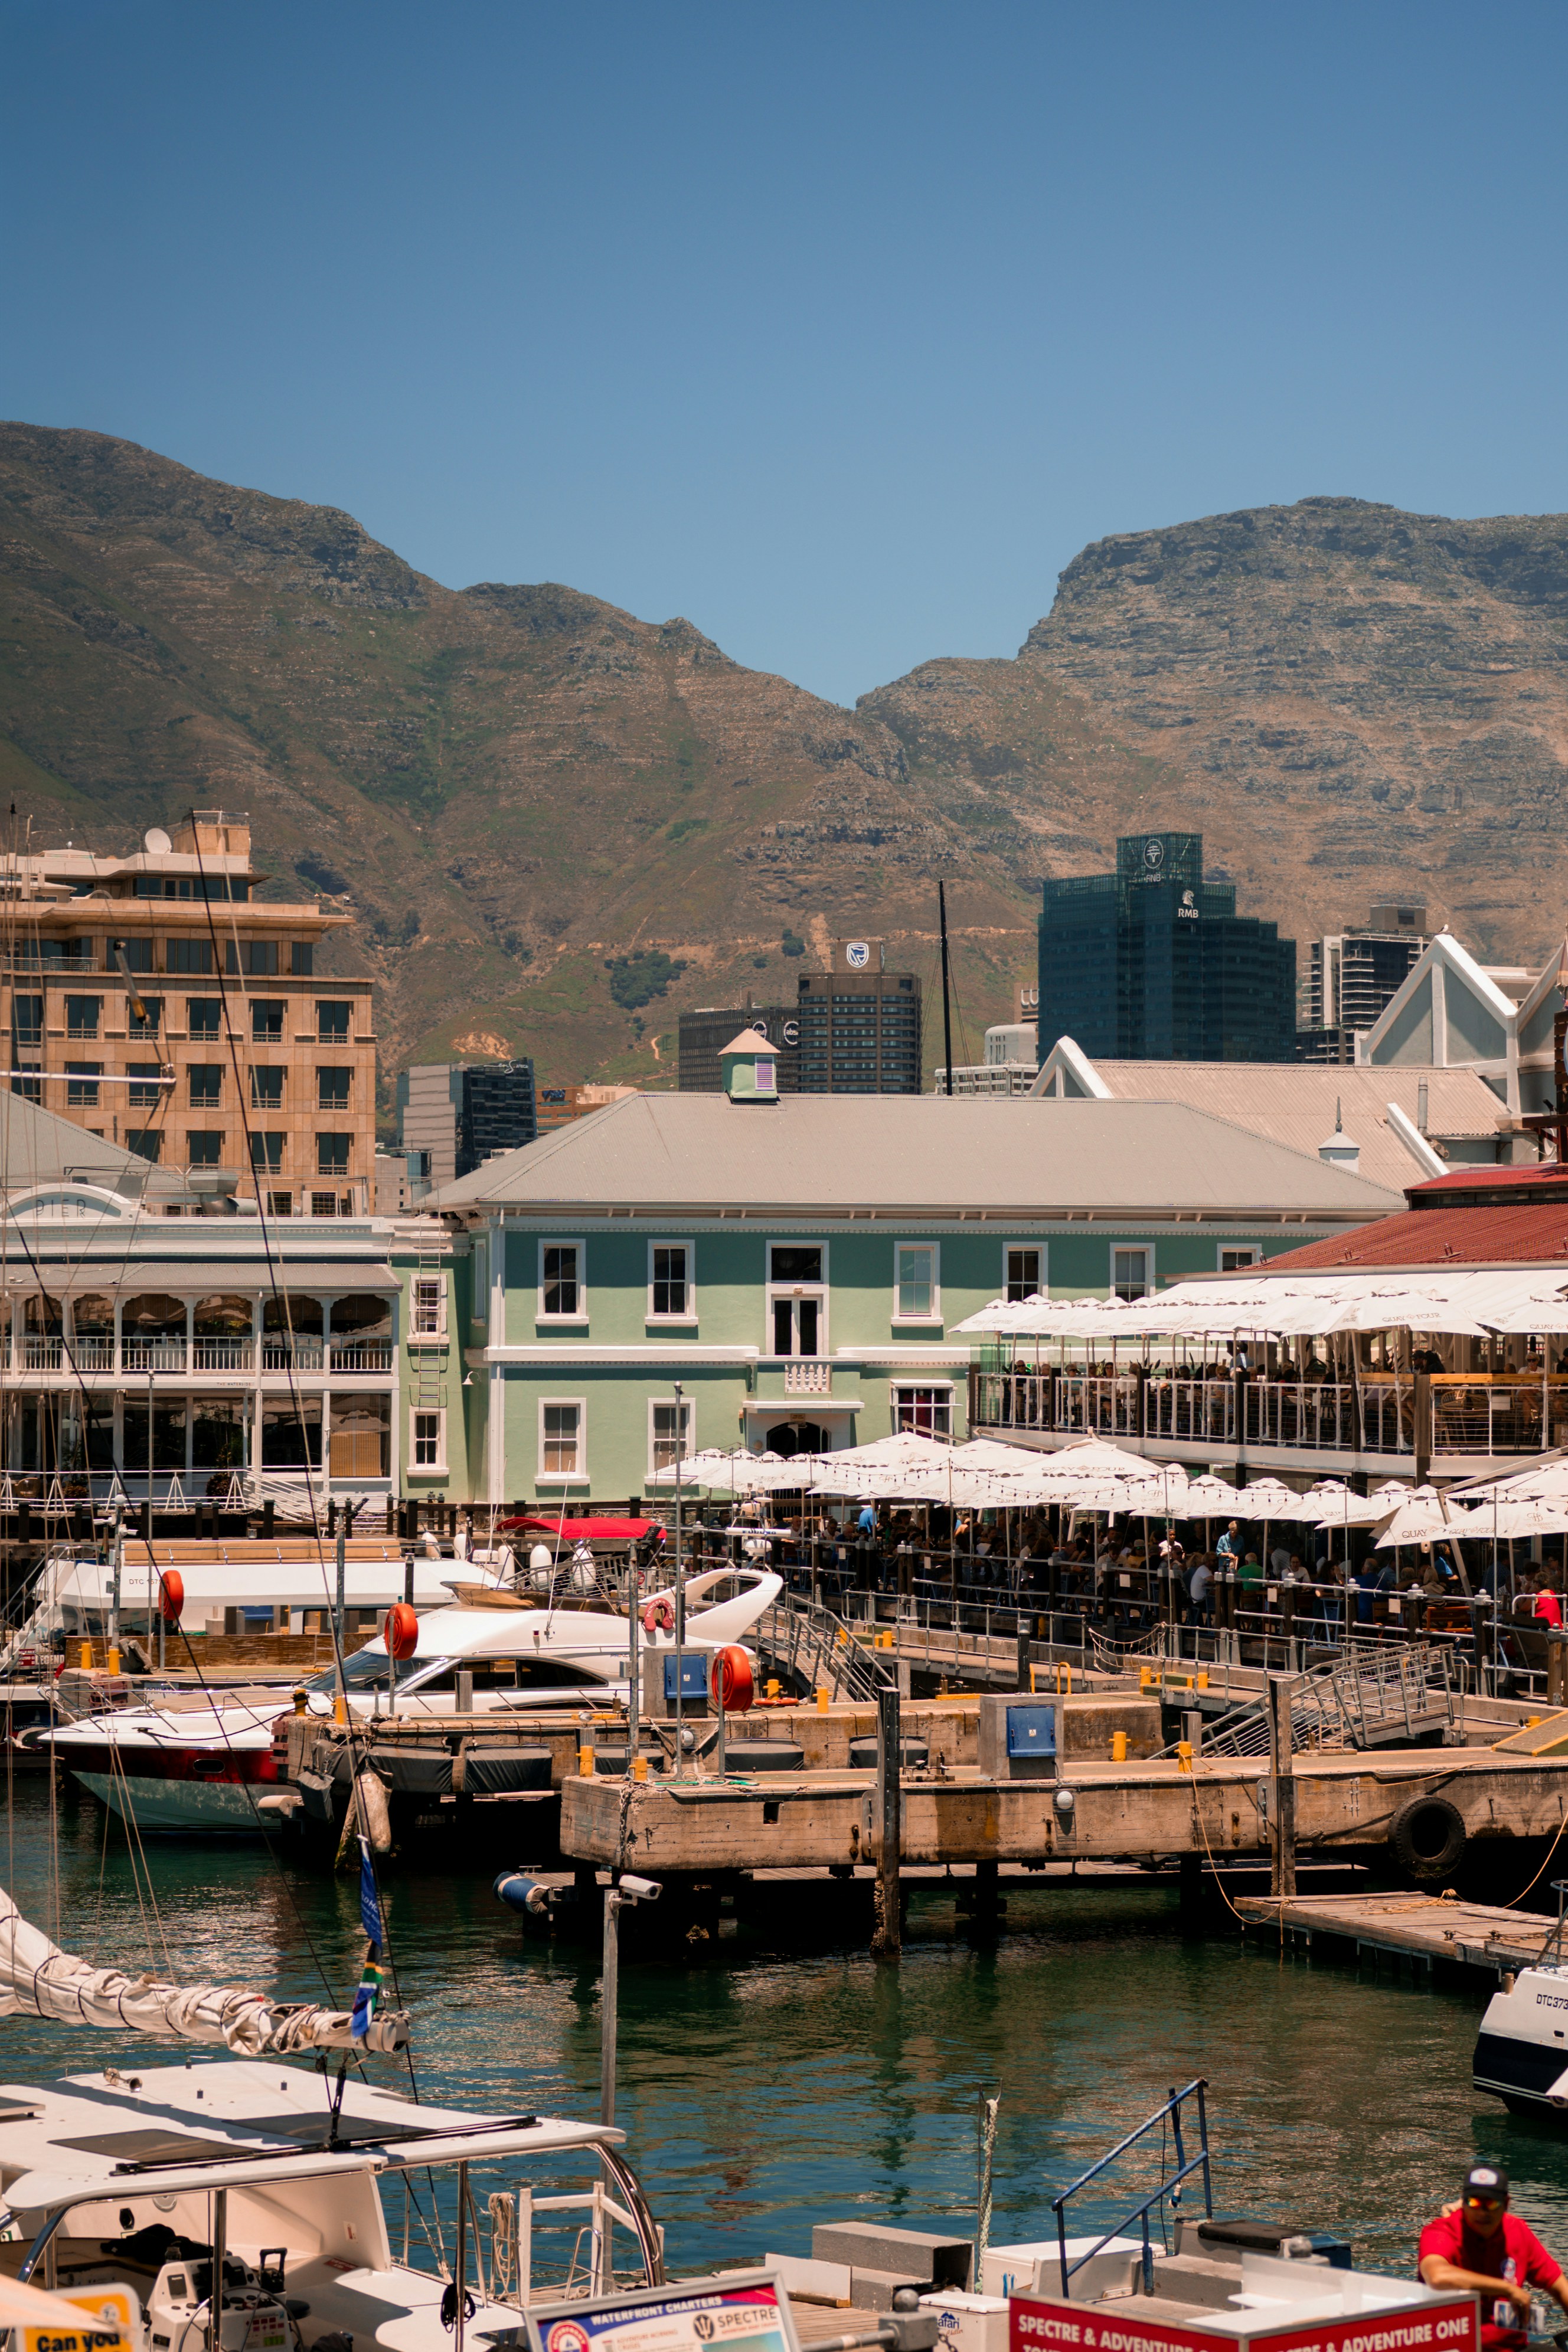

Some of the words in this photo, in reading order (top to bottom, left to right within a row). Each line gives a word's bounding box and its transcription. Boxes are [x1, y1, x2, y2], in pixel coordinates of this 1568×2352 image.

[1146, 874, 1161, 882] FNB
[1178, 908, 1198, 918] RMB
[36, 1200, 86, 1219] PIER
[1402, 1529, 1427, 1538] QUAY
[35, 1655, 65, 1665] LEGEND
[592, 2304, 664, 2326] WATERFRONT
[666, 2295, 723, 2314] CHARTERS
[717, 2307, 778, 2328] SPECTRE
[936, 2317, 959, 2329] afari
[1018, 2314, 1080, 2343] SPECTRE
[1084, 2327, 1096, 2347] &
[1341, 2323, 1433, 2352] ADVENTURE
[1436, 2316, 1470, 2339] ONE
[37, 2335, 77, 2352] Can
